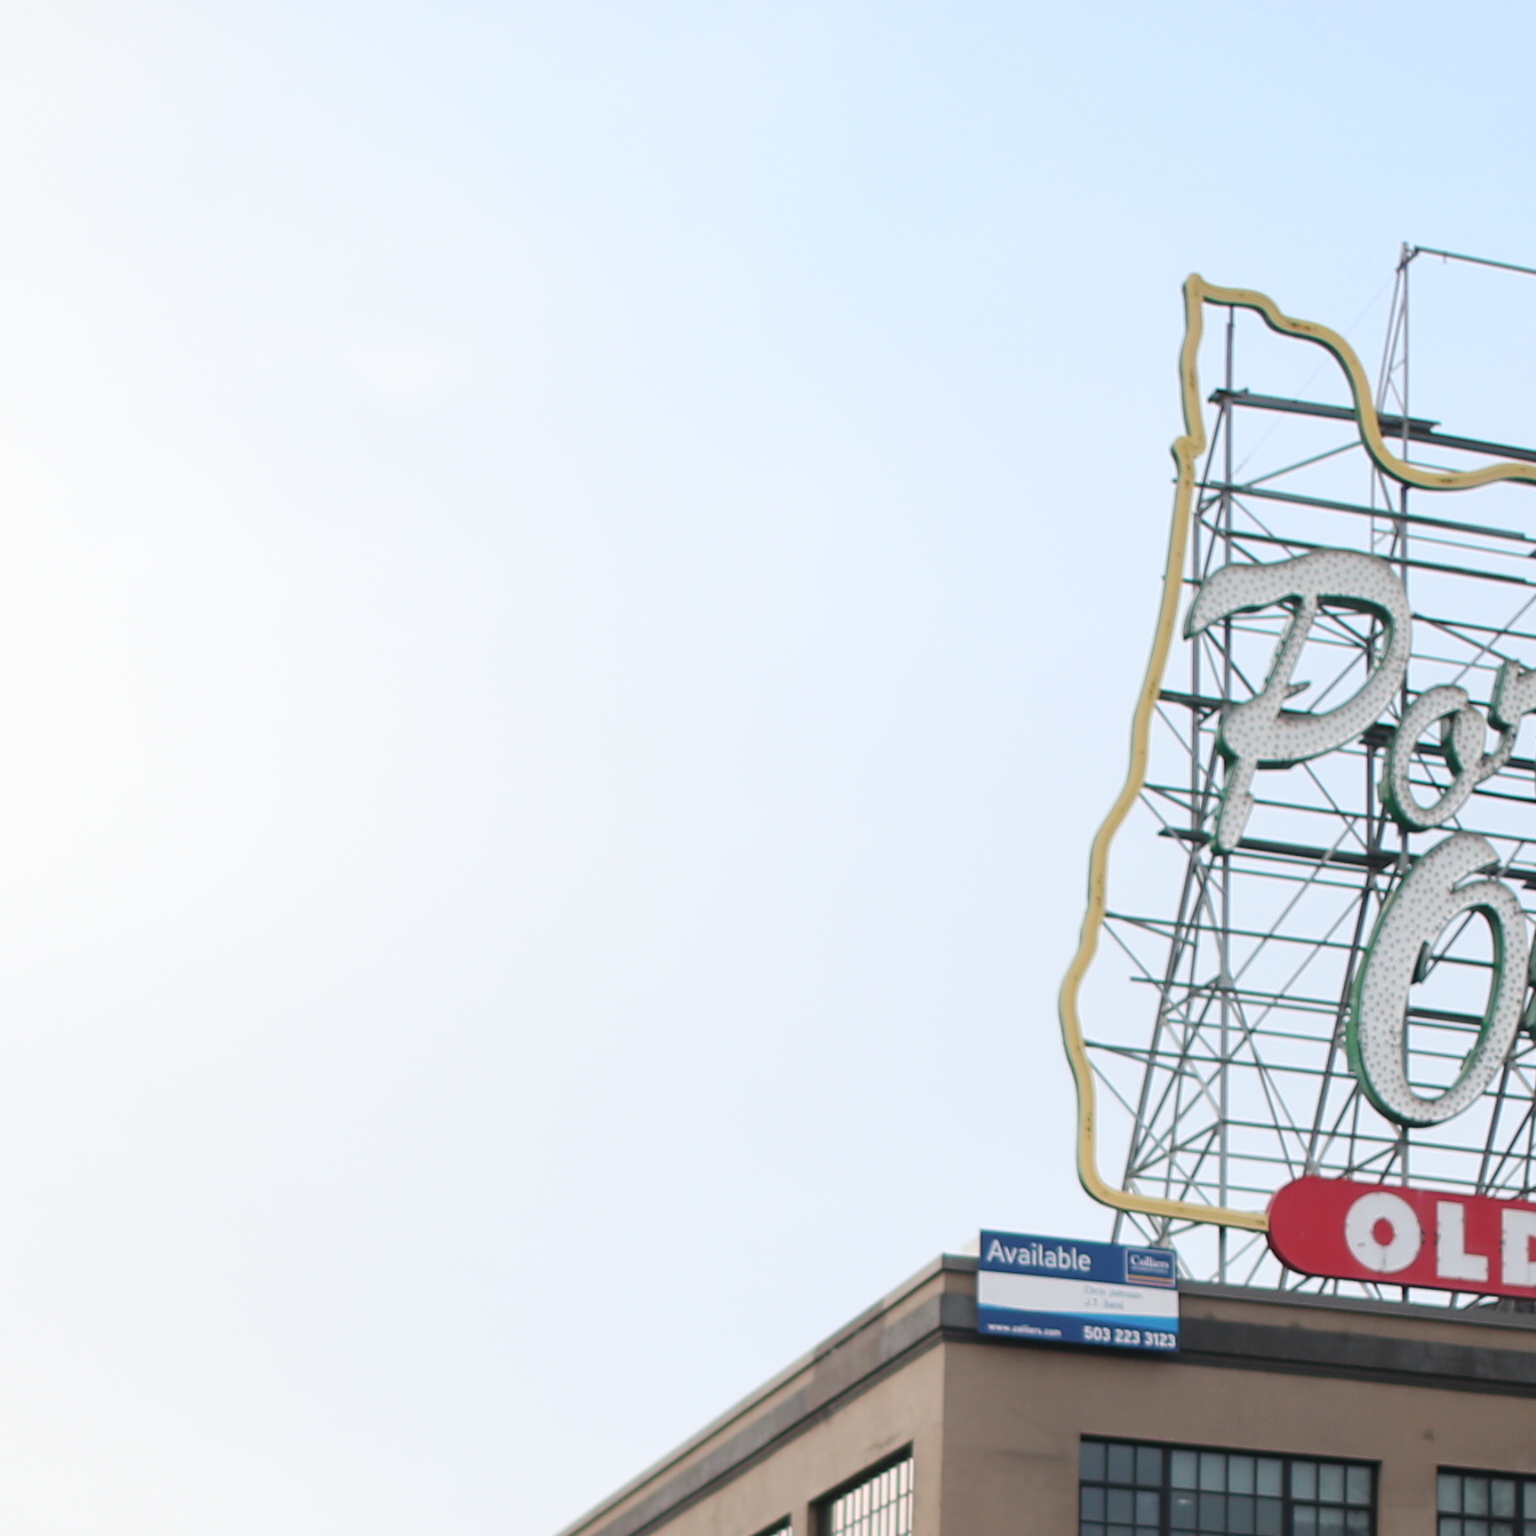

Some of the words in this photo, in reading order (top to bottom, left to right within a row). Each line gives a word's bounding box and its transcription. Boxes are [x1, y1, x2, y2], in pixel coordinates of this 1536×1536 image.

[986, 1239, 1092, 1272] Available
[1129, 1253, 1171, 1269] Colliers
[1083, 1325, 1111, 1342] 503
[1114, 1327, 1141, 1345] 223
[1144, 1332, 1177, 1349] 3123
